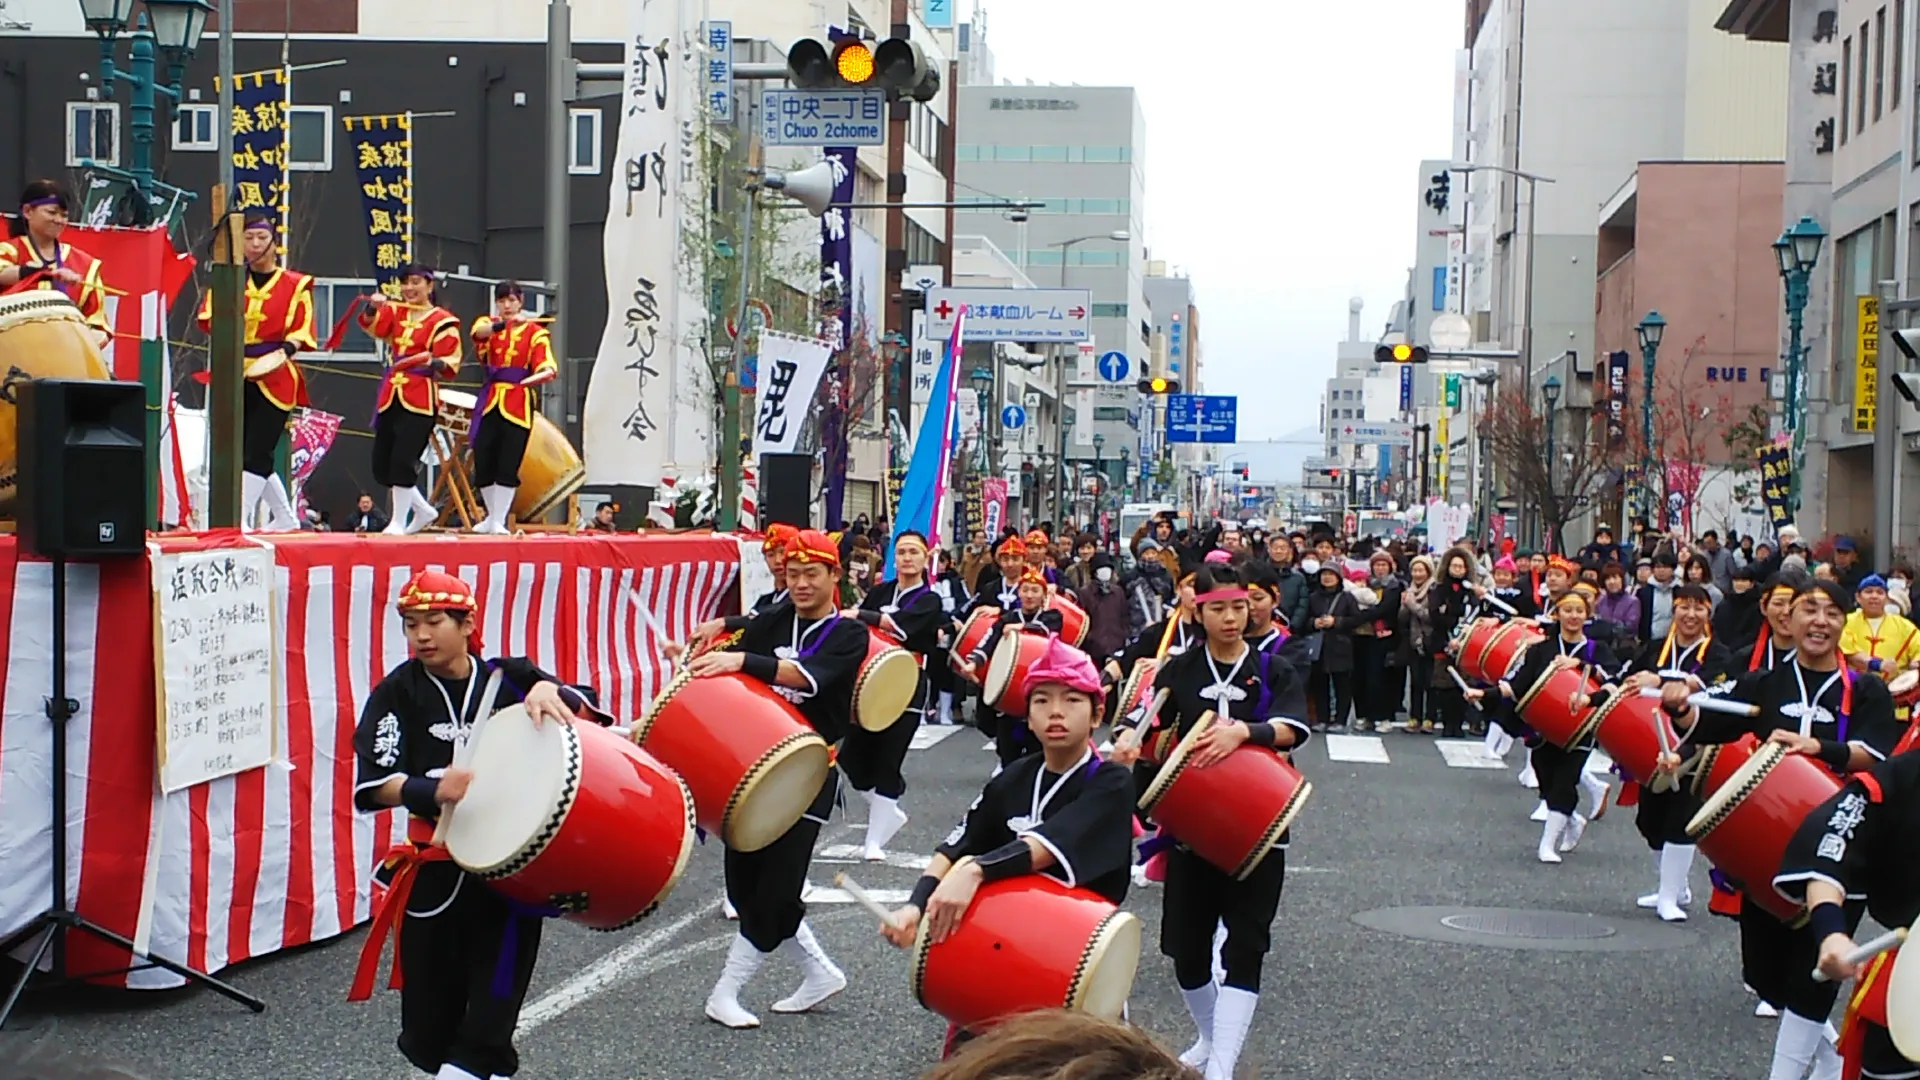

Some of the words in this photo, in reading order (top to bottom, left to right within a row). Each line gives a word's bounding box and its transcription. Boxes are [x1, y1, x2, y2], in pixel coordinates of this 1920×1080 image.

[782, 97, 879, 121] 中央二丁目
[784, 122, 818, 138] Chuo
[824, 122, 878, 138] 2chome
[1706, 366, 1747, 382] RUE
